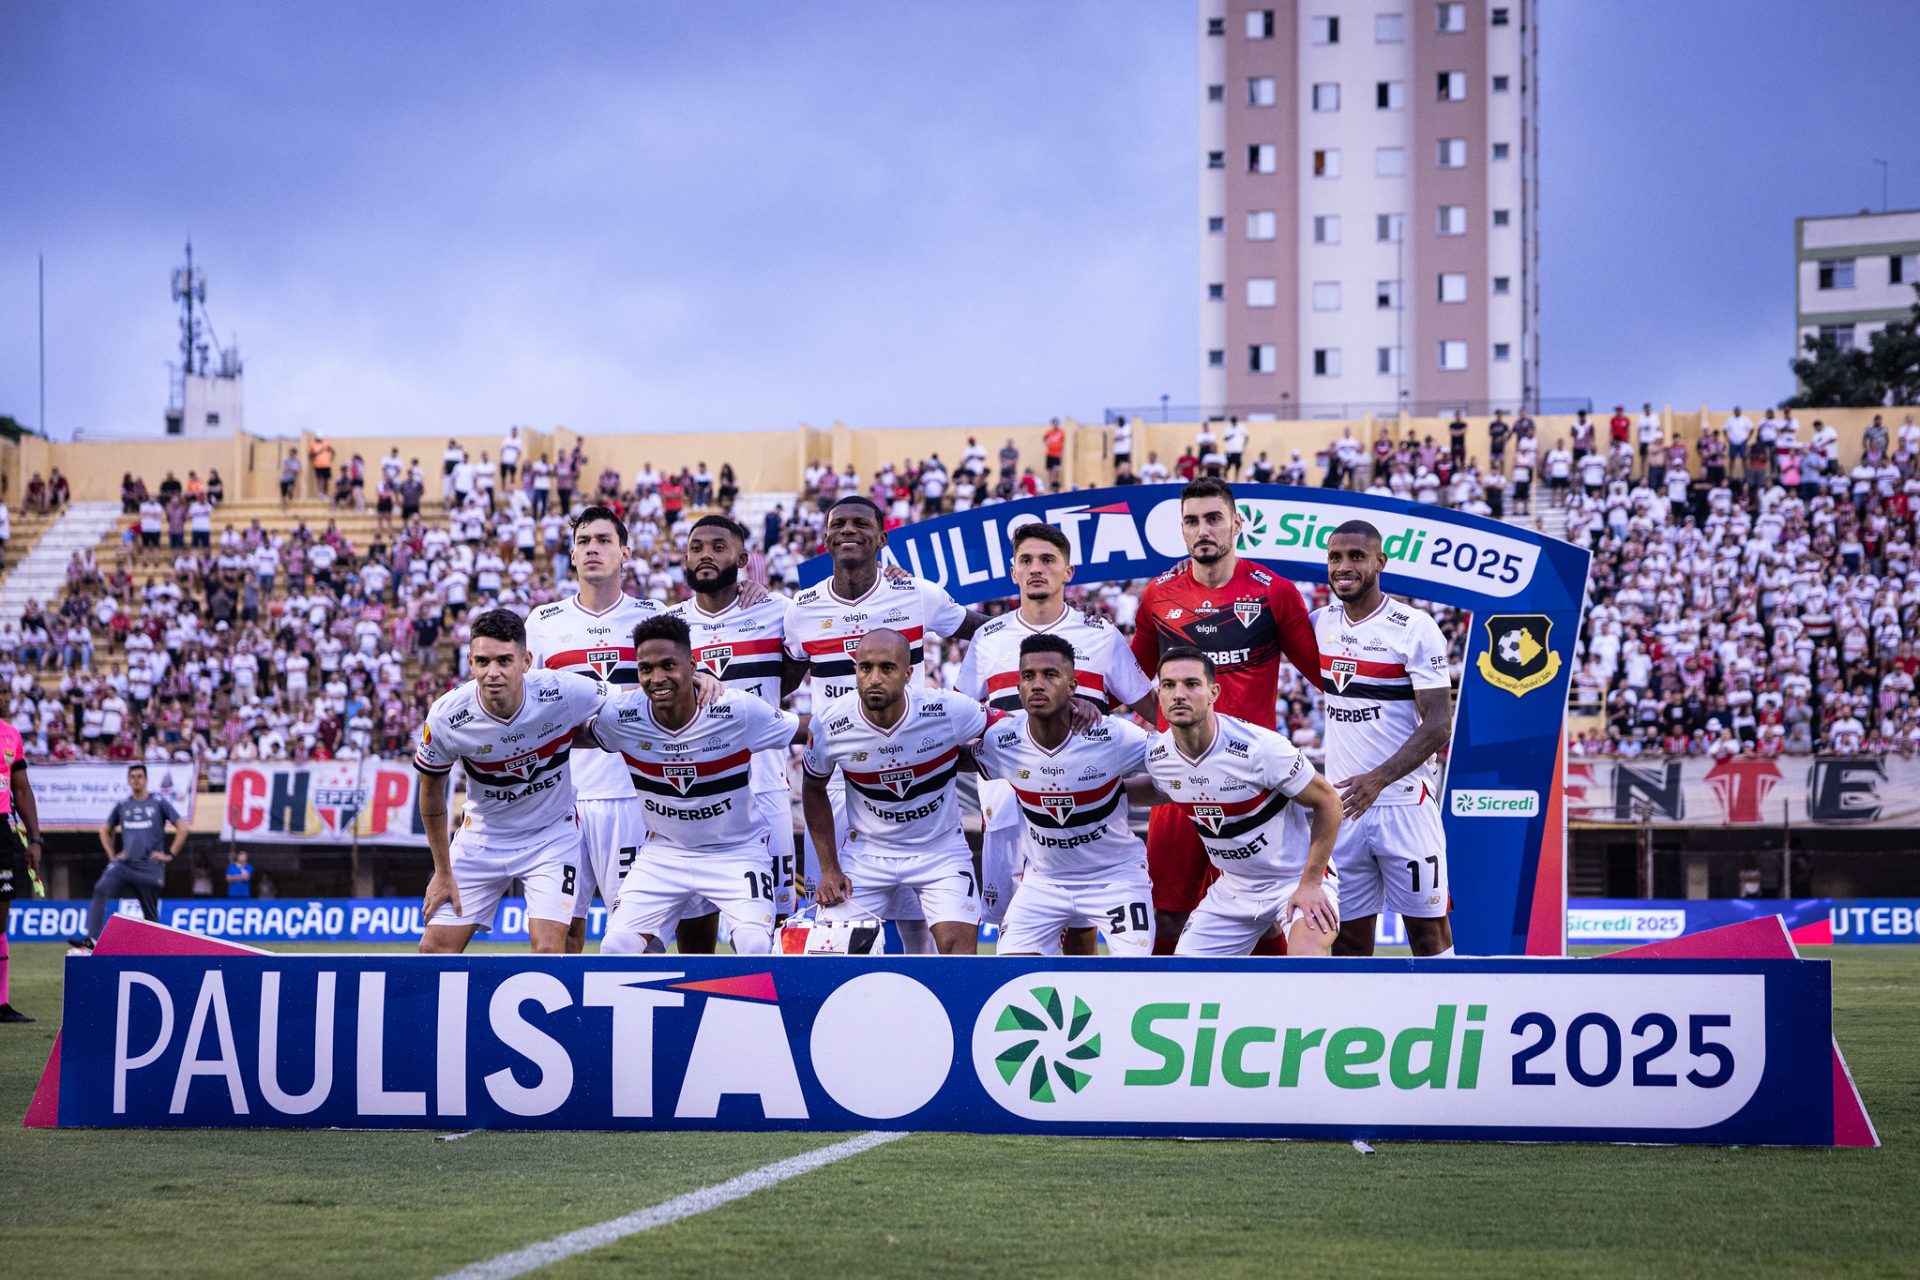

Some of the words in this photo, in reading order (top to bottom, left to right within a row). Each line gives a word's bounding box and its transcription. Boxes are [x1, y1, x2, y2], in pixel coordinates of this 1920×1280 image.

[1276, 513, 1427, 563] Sicdi
[1430, 537, 1524, 584] 2025
[843, 613, 868, 623] elgin
[883, 615, 910, 624] ADEMICON
[587, 626, 611, 635] elgin
[1196, 625, 1217, 635] elgin
[1341, 635, 1358, 645] elgin
[589, 652, 617, 661] SPFC
[703, 648, 731, 660] SPFC
[1202, 648, 1250, 665] RBET
[1333, 662, 1356, 672] SPFC
[537, 695, 563, 703] TRICOLOR
[539, 688, 560, 698] VIVA
[618, 708, 638, 718] VIVA
[709, 706, 731, 714] VIVA
[922, 703, 944, 712] VIVA
[448, 709, 470, 725] VIVA
[450, 715, 475, 731] TRICOLOR
[617, 716, 642, 725] TRICOLOR
[829, 716, 849, 731] VIVA
[537, 724, 562, 739] ADEMICON
[830, 723, 854, 737] TRICOLOR
[1086, 728, 1109, 736] VIVA
[500, 733, 525, 745] elgin
[998, 731, 1017, 744] VIVA
[998, 738, 1022, 749] TRICOLOR
[663, 743, 689, 753] elgin
[702, 743, 730, 752] ADEMICON
[878, 745, 904, 755] elgin
[916, 742, 944, 754] ADEMICON
[1149, 745, 1165, 757] VIVA
[1229, 740, 1249, 752] VIVA
[1225, 747, 1249, 759] TRICOLOR
[507, 755, 537, 769] SPFC
[666, 768, 695, 776] SPFC
[881, 772, 912, 782] SPFC
[1040, 766, 1065, 776] elgin
[1078, 772, 1107, 782] ADEMICON
[1188, 776, 1210, 786] elgin
[1219, 784, 1247, 792] ADEMICON
[228, 769, 310, 832] CH
[1043, 798, 1073, 806] SPFC
[1477, 796, 1534, 811] Sicredi
[644, 798, 732, 821] SUPERBET
[863, 792, 945, 823] SUPERBET
[1029, 824, 1109, 850] SUPERBET
[1406, 855, 1439, 892] 17
[562, 864, 576, 896] 8
[958, 871, 974, 897] 7
[744, 871, 774, 902] 18
[172, 902, 344, 938] FEDERAÇÃO
[1107, 902, 1149, 935] 20
[1636, 917, 1679, 931] 2025
[1123, 1002, 1487, 1091] Sicredi
[1510, 1012, 1736, 1088] 2025
